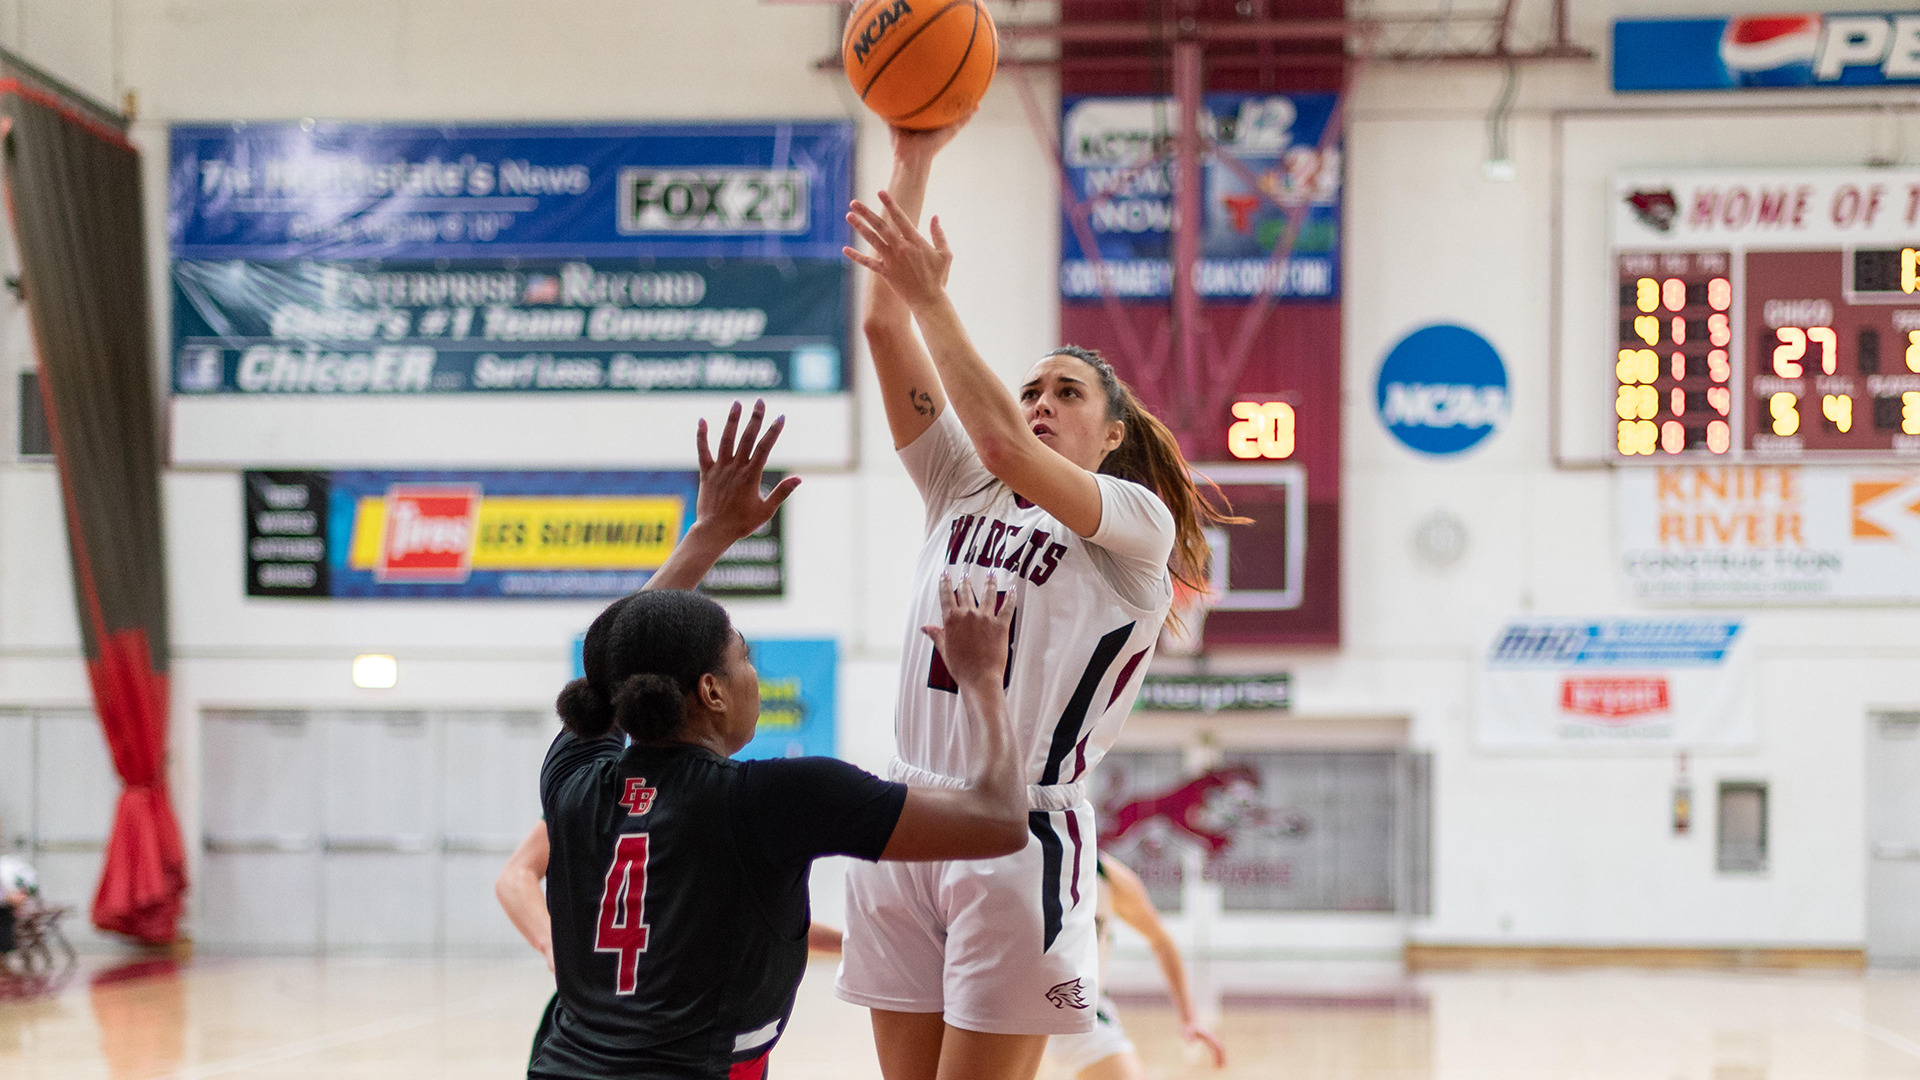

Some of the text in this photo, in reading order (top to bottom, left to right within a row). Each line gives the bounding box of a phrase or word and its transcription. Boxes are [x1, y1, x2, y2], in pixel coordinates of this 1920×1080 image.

[853, 0, 913, 65] NCAA
[498, 158, 592, 196] News
[632, 176, 798, 224] FOX 20
[1688, 184, 1811, 232] HOME
[1829, 183, 1883, 230] OF
[418, 306, 474, 342] #1
[483, 307, 586, 342] Team
[586, 306, 769, 346] Coverage
[236, 346, 437, 391] ChicoER
[1773, 327, 1837, 379] 27
[1383, 383, 1509, 428] NCAA
[1769, 391, 1800, 437] 5
[1822, 394, 1852, 433] 4
[1226, 401, 1296, 459] 20
[1655, 465, 1804, 501] KNIFE
[946, 514, 1068, 587] WILDCATS
[1657, 514, 1807, 546] RIVER
[618, 777, 657, 817] EB
[594, 832, 650, 996] 4
